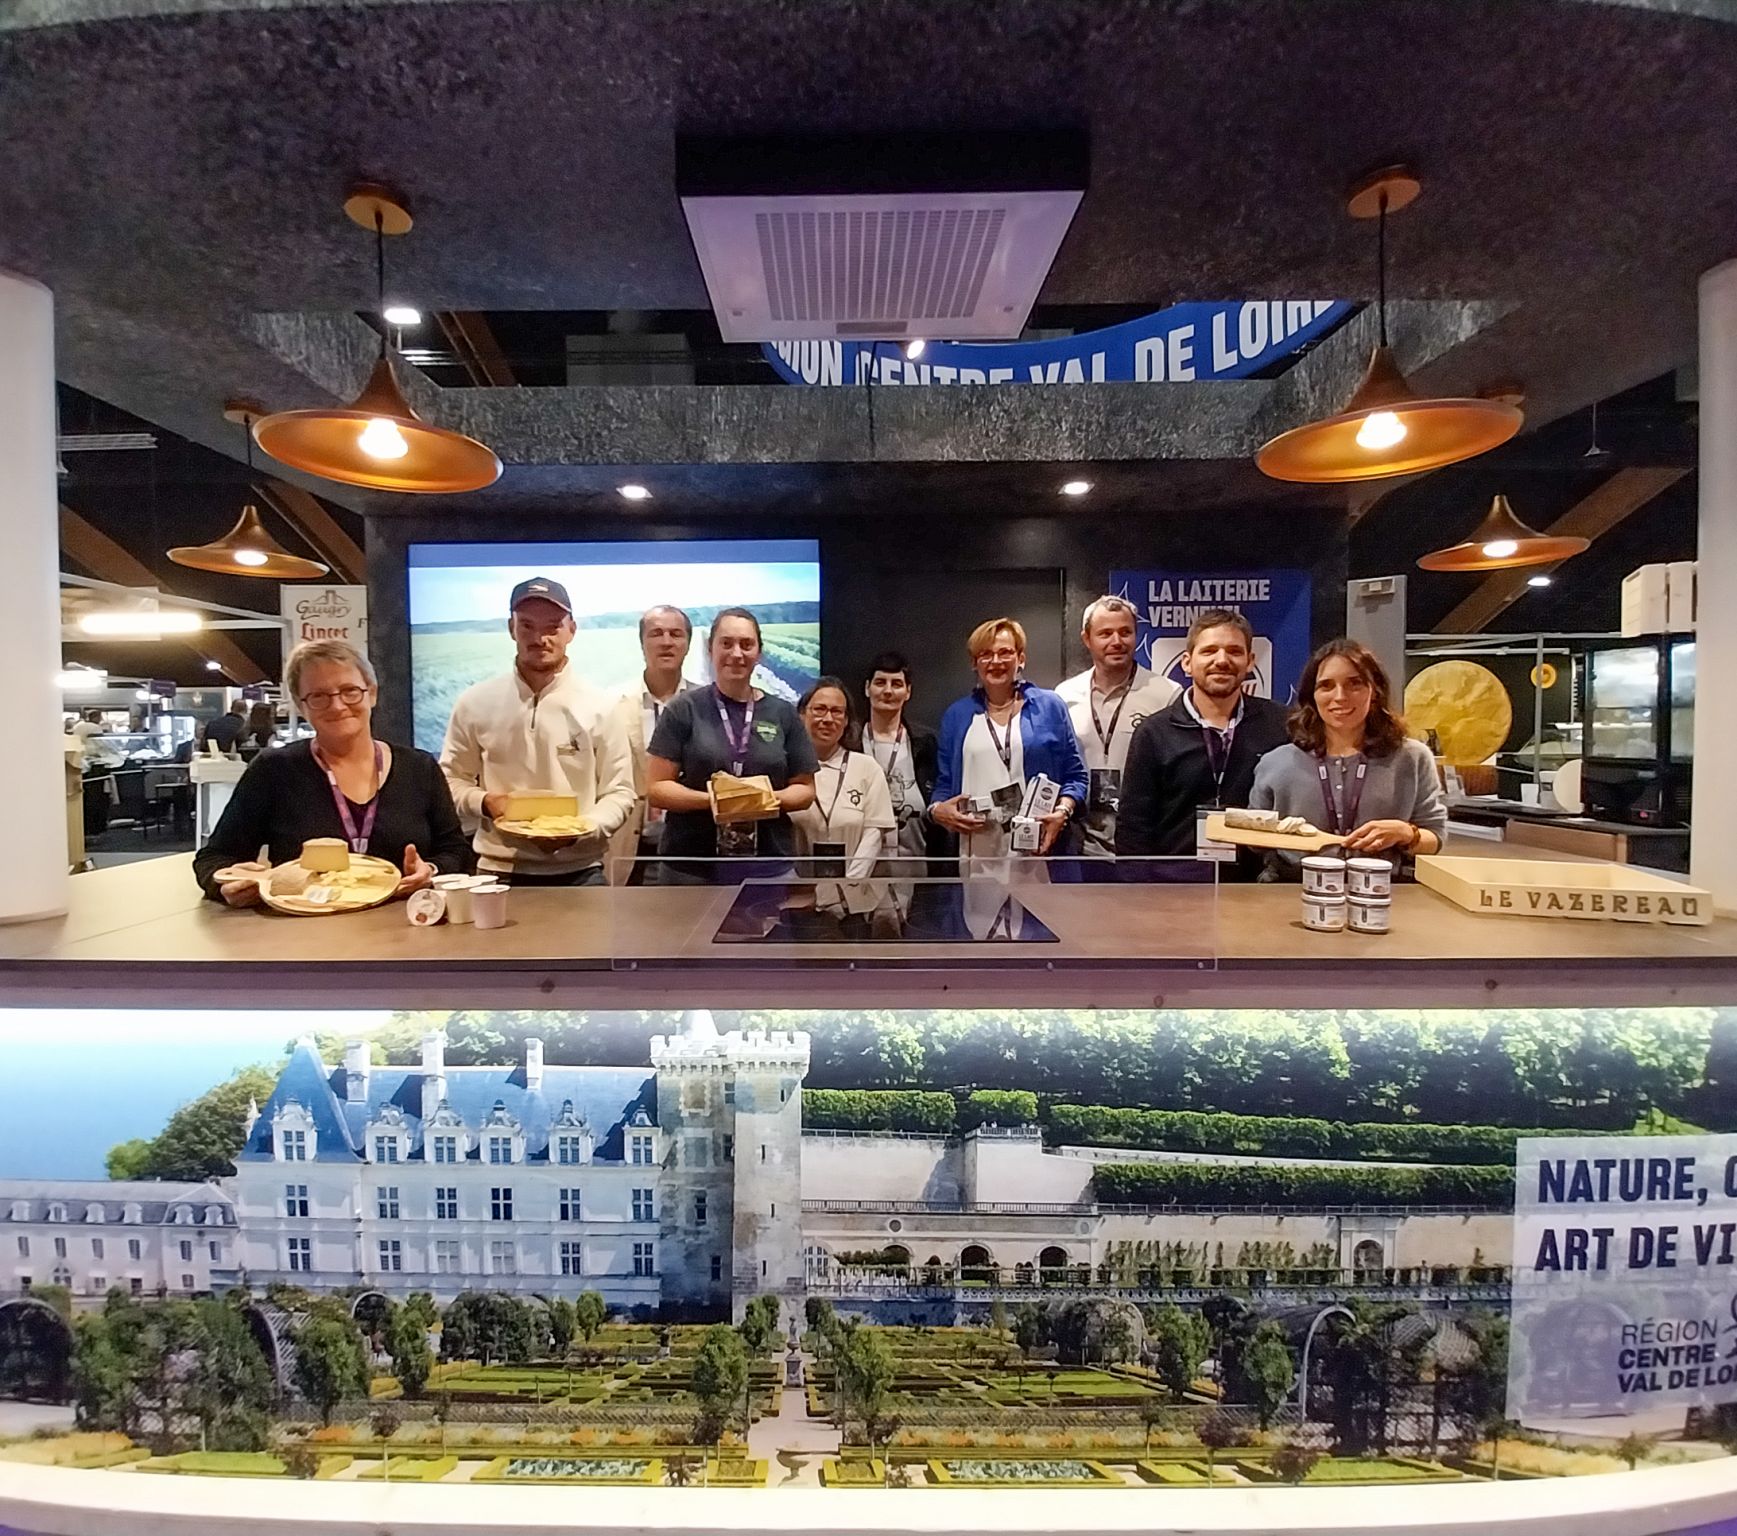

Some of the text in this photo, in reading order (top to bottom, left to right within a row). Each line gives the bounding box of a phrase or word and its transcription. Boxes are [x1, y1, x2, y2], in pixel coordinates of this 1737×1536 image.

[1135, 324, 1195, 382] DE
[1212, 301, 1334, 373] LOIR
[1148, 579, 1270, 602] LA LAITERIE
[1480, 890, 1699, 916] LE VAZEREAU
[1538, 1157, 1708, 1206] NATURE,
[1534, 1228, 1614, 1271] ART
[1628, 1226, 1679, 1269] DE
[1622, 1317, 1718, 1344] RÉGION
[1618, 1343, 1716, 1370] CENTRE
[1618, 1371, 1663, 1393] VAL
[1668, 1367, 1700, 1390] DE
